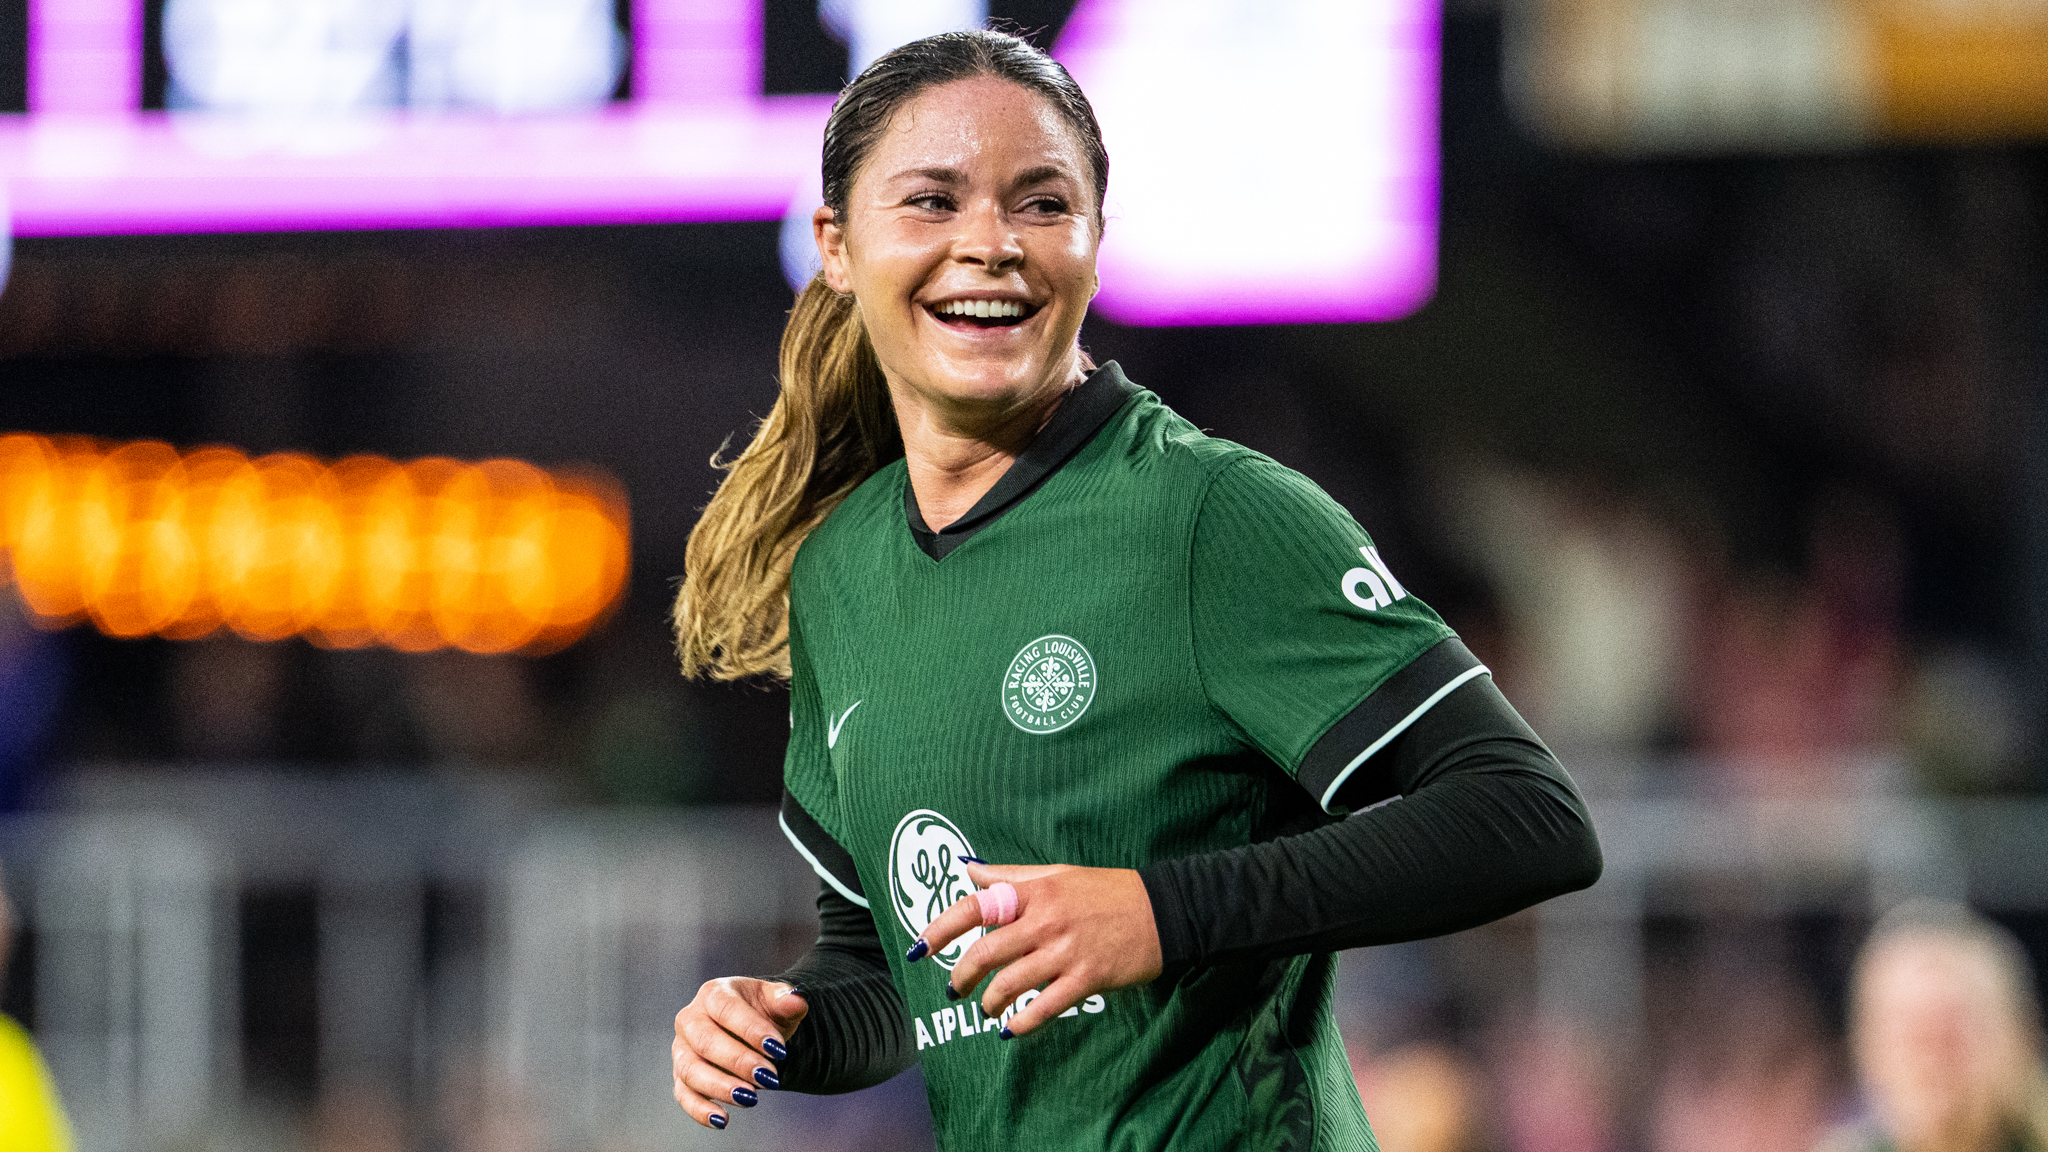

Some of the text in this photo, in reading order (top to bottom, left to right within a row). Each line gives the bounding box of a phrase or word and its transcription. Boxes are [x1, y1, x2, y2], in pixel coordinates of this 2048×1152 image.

[1008, 641, 1090, 689] RACING LOUISVILLE
[1009, 694, 1084, 726] FOOTBALL CLUB
